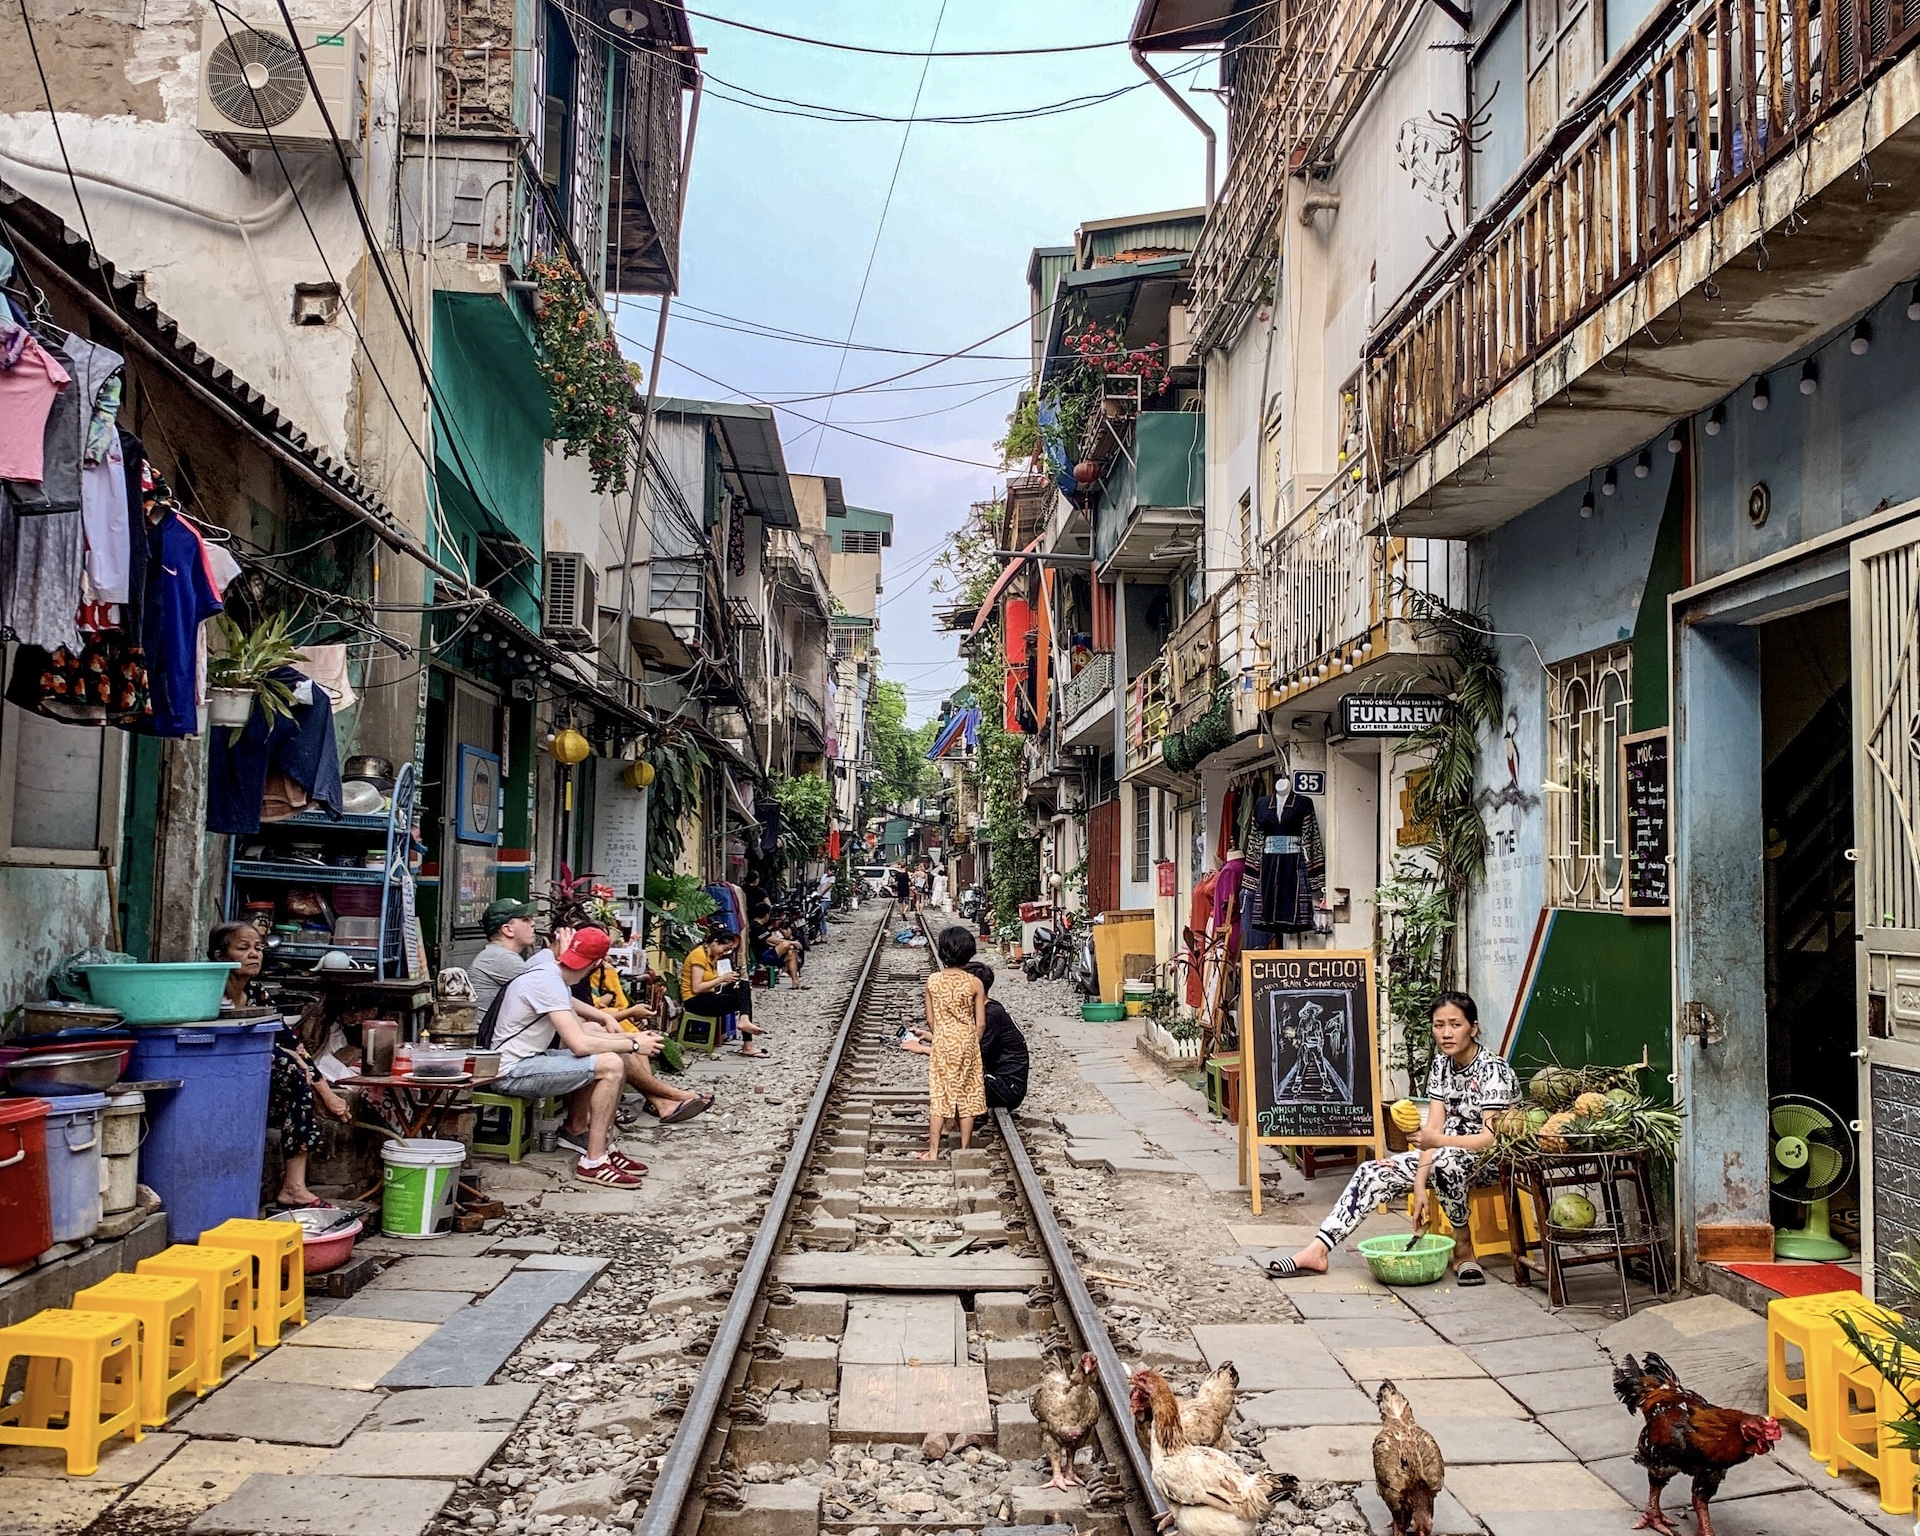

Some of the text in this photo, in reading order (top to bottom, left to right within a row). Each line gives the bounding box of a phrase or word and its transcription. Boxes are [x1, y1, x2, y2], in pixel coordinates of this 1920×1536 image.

[1349, 707, 1444, 722] FURBREW
[1298, 774, 1319, 791] 35
[1252, 960, 1365, 983] CHOO CHOO!
[1270, 1105, 1365, 1115] WHICH ONE CAME FIRST
[1277, 1113, 1326, 1124] the houses
[1280, 1126, 1296, 1136] the
